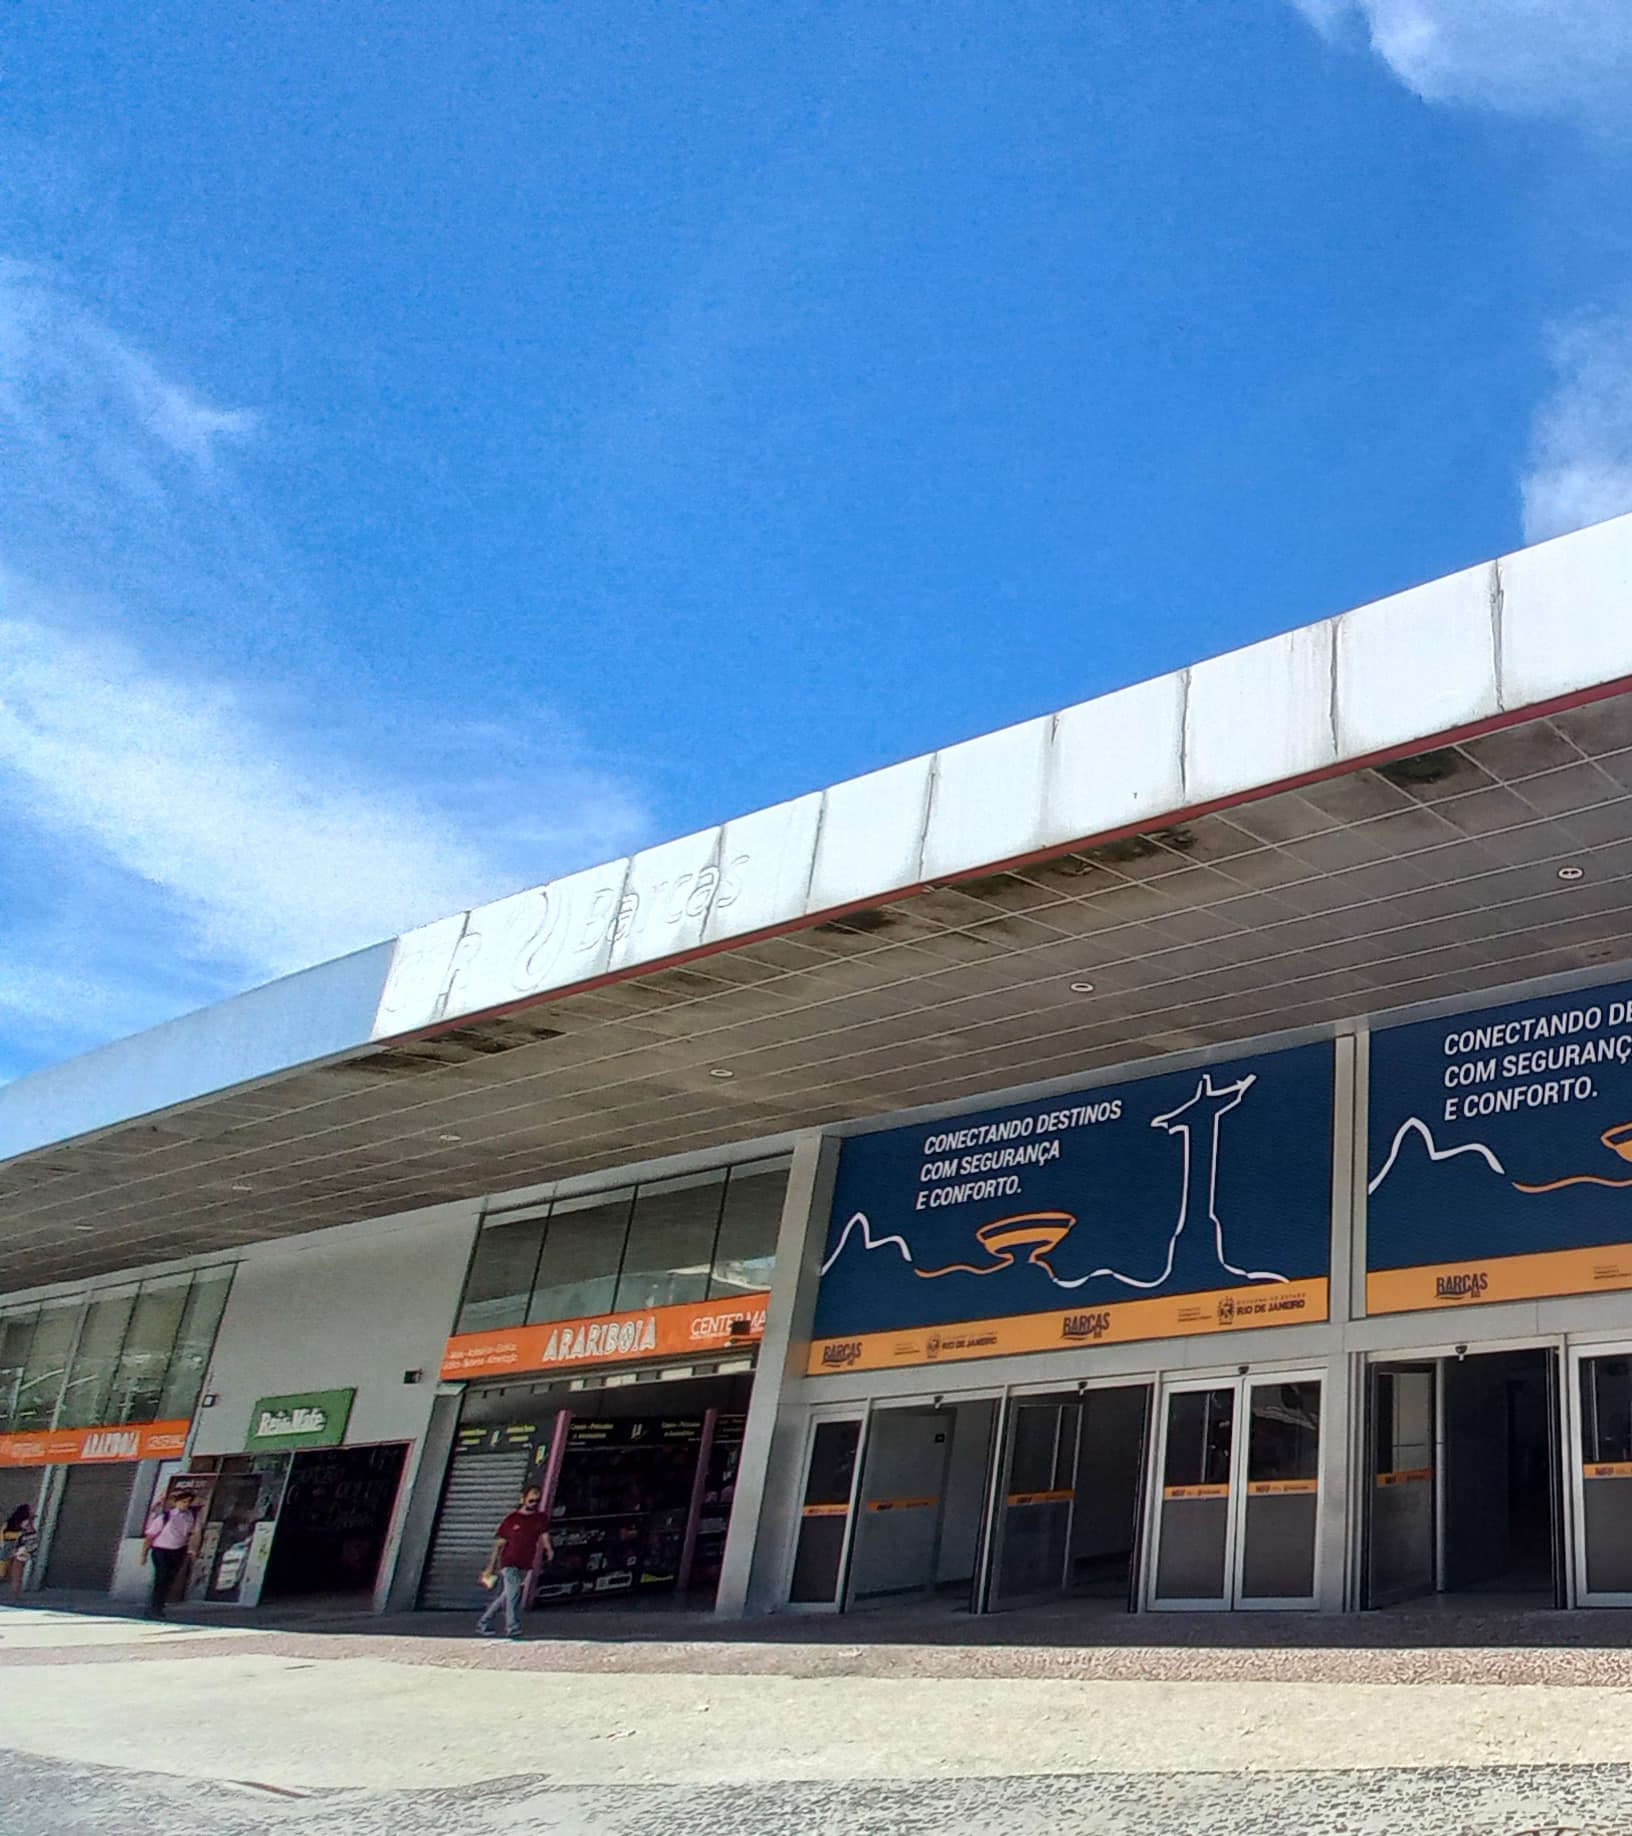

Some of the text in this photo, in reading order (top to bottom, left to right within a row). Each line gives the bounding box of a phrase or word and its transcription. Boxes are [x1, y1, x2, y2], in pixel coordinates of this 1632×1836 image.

[1444, 1007, 1601, 1055] CONECTANDO
[1444, 1059, 1496, 1087] COM
[1444, 1076, 1598, 1121] E CONFORTO.
[924, 1100, 1122, 1154] CONECTANDO DESTINOS
[920, 1140, 1060, 1182] COM SEGURANÇA
[915, 1175, 1022, 1210] E CONFORTO.
[1436, 1272, 1488, 1296] BARCAS
[1062, 1312, 1111, 1336] BARCAS
